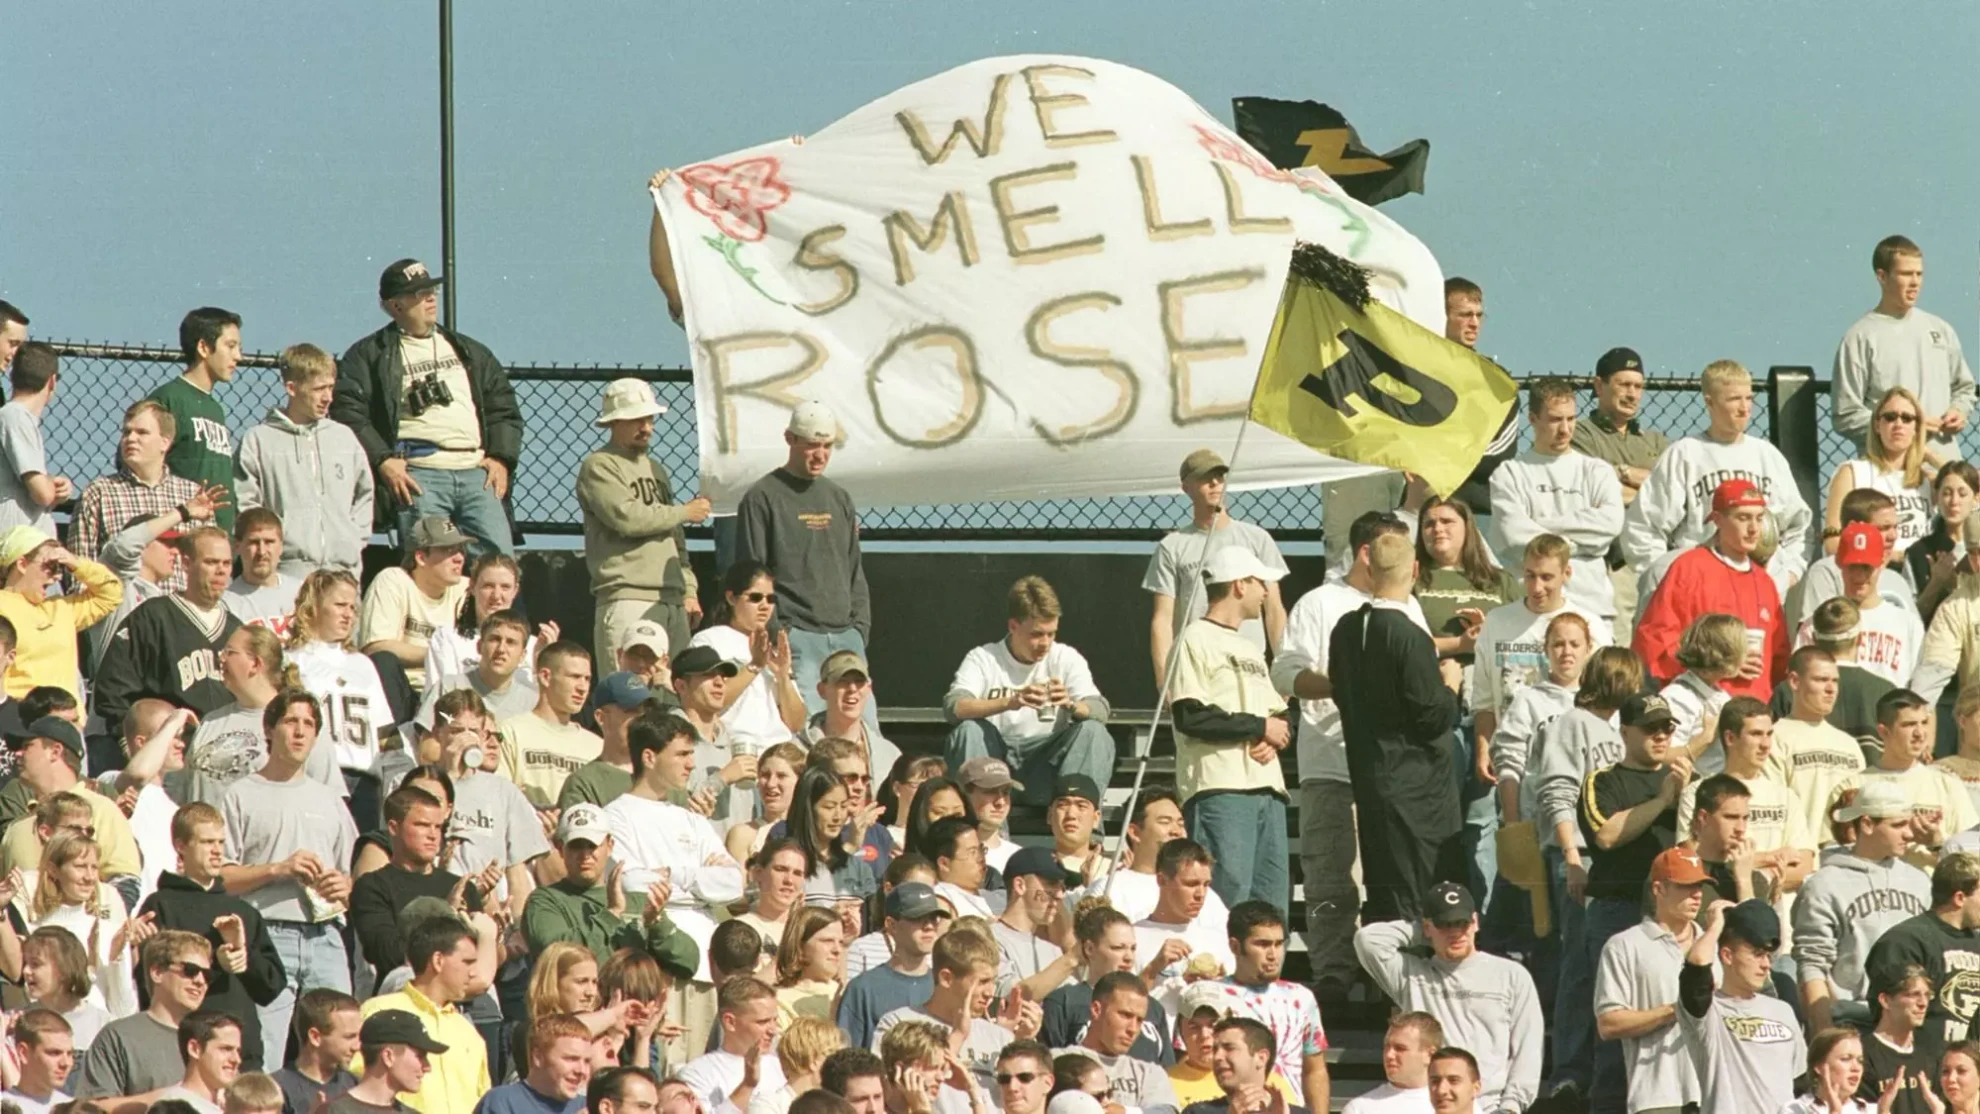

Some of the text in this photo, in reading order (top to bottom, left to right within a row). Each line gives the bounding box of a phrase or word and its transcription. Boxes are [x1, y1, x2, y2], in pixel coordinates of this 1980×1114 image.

[895, 63, 1119, 165] WE
[792, 154, 1294, 317] SMELL
[699, 262, 1408, 459] ROSE
[1298, 327, 1459, 428] P
[334, 463, 345, 480] 3
[177, 648, 223, 692] BOIL
[1856, 630, 1902, 671] STATE
[323, 692, 370, 746] 15
[1445, 891, 1460, 905] C
